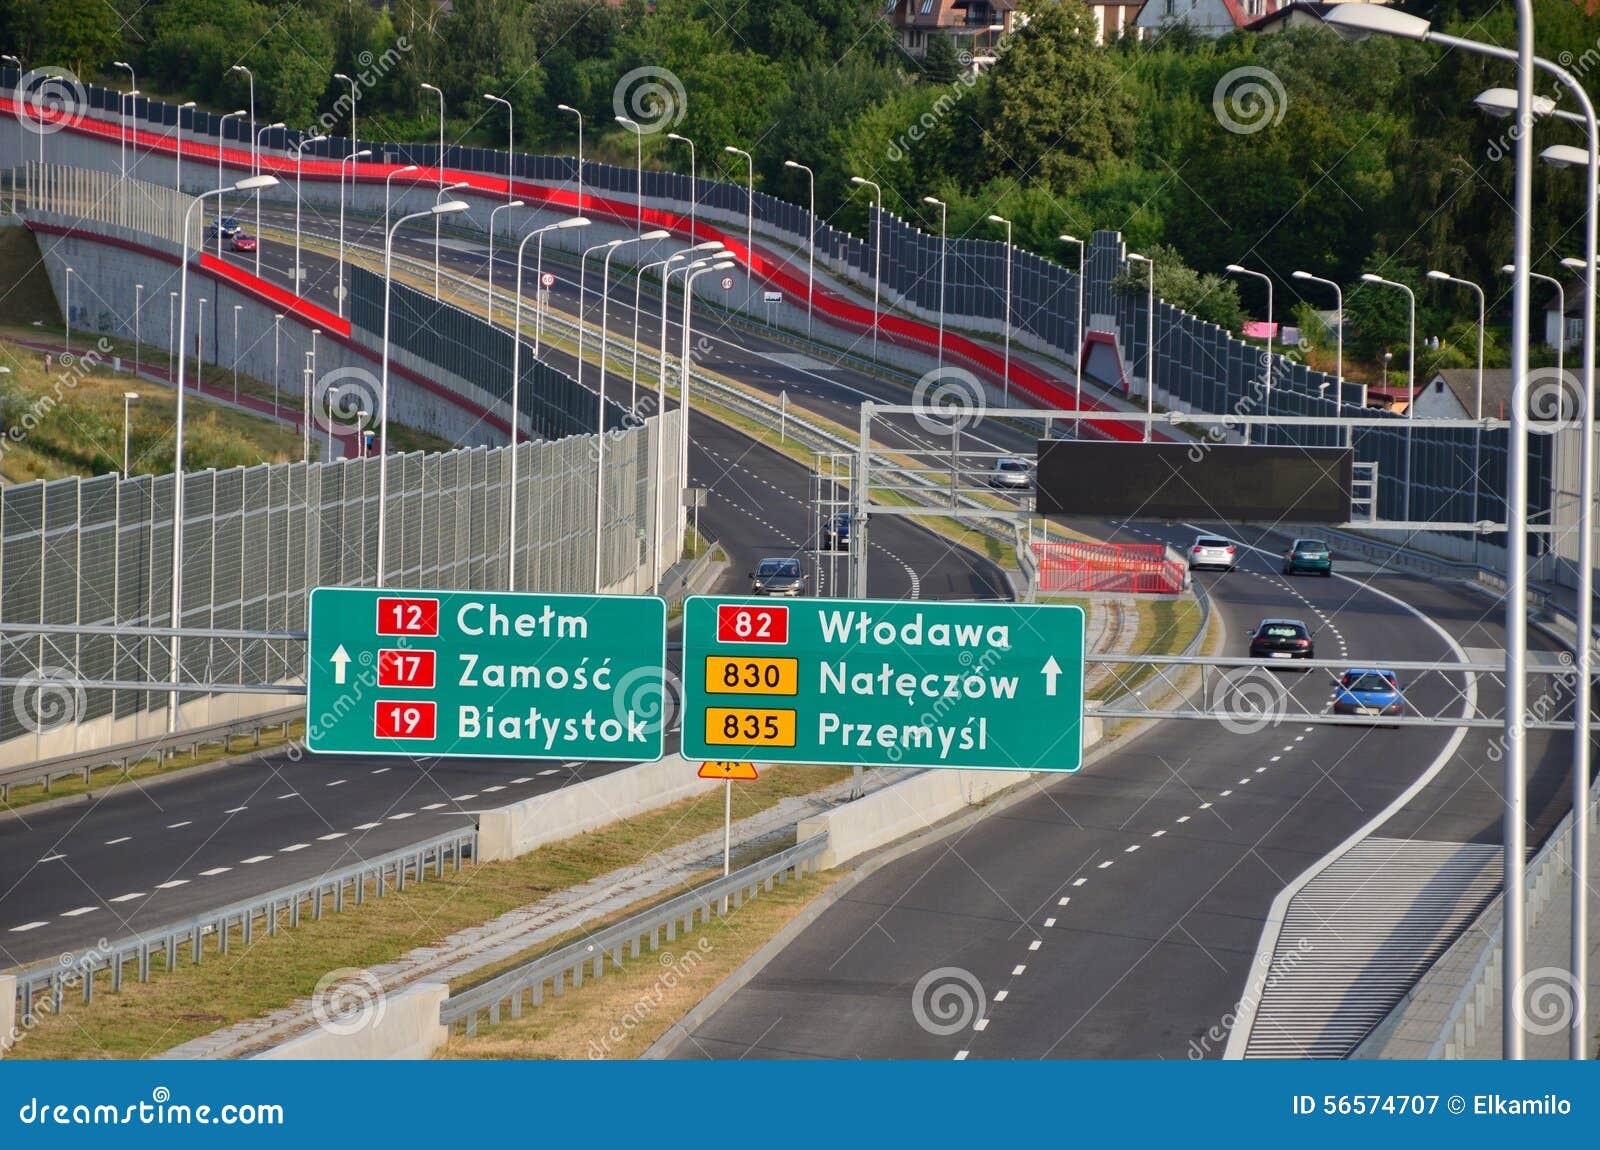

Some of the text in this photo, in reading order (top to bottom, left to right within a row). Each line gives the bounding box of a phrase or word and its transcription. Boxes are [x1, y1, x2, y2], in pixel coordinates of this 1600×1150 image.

[392, 602, 588, 638] 12 Chełm
[735, 610, 1010, 648] 82 Włodawa
[393, 653, 612, 691] 17 Zamość
[722, 662, 1019, 706] 830 Nałęczów
[390, 705, 647, 750] 19 Białystok
[722, 713, 987, 759] 835 Przemyśl
